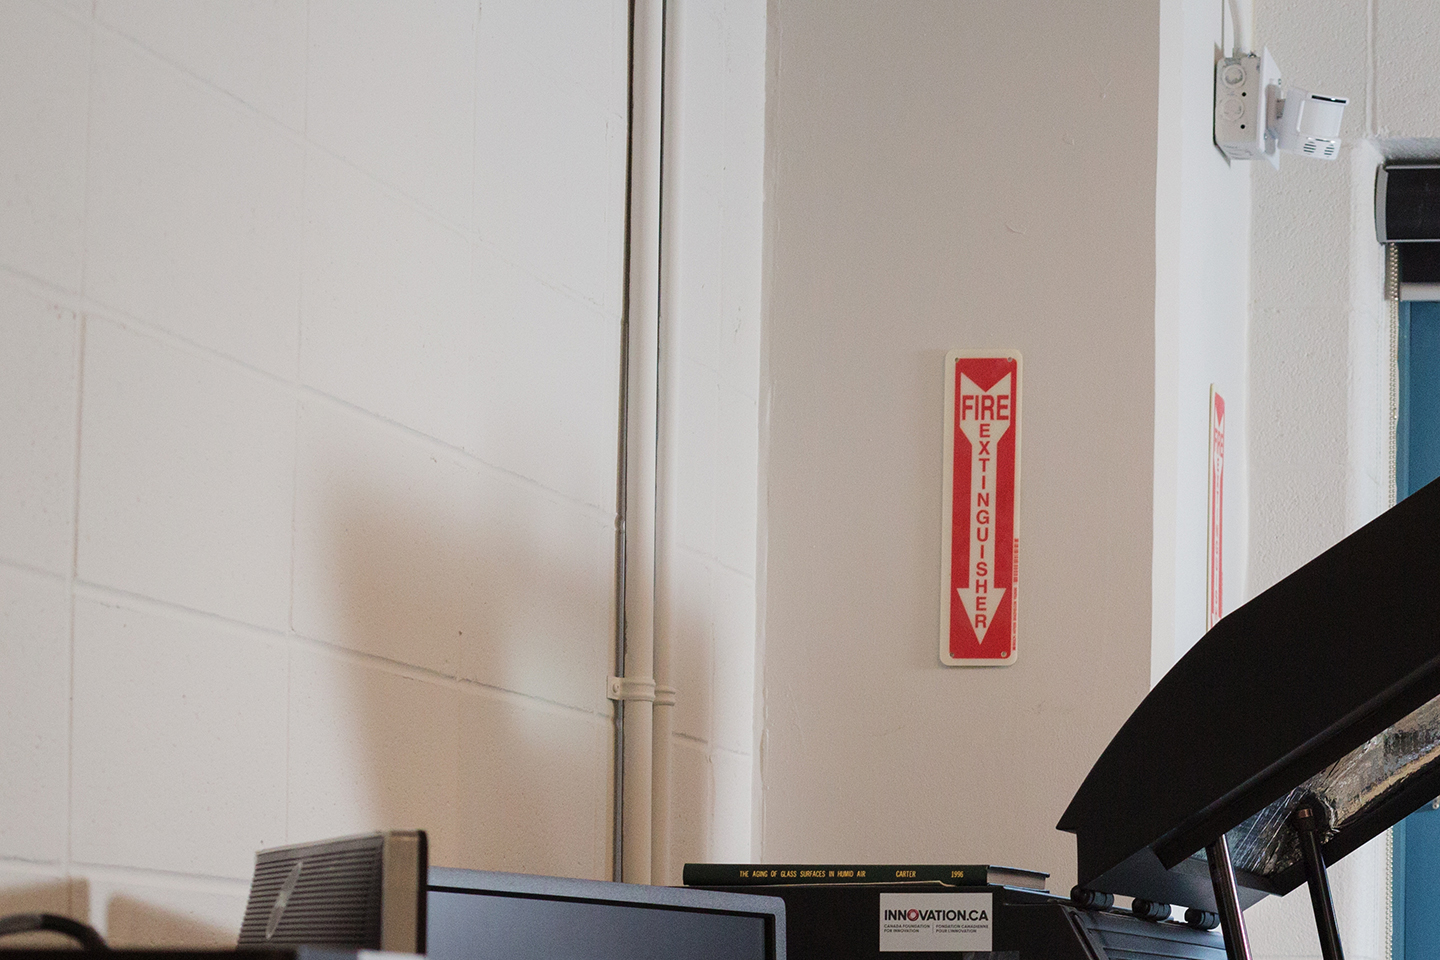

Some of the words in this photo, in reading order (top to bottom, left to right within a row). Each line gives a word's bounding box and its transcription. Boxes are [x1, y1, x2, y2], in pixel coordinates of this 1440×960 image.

[962, 394, 1009, 421] FIRE
[975, 423, 991, 629] EXTINGUISHER
[739, 870, 749, 878] THE
[752, 870, 768, 878] AGING
[770, 870, 778, 878] OF
[780, 870, 797, 878] GLASS
[799, 870, 826, 878] SURFACES
[828, 870, 835, 878] IN
[836, 870, 854, 878] HUMID
[856, 870, 866, 878] AIR
[895, 870, 917, 878] CARTER
[950, 870, 964, 878] 1996
[884, 908, 988, 921] INNOVATION.CA
